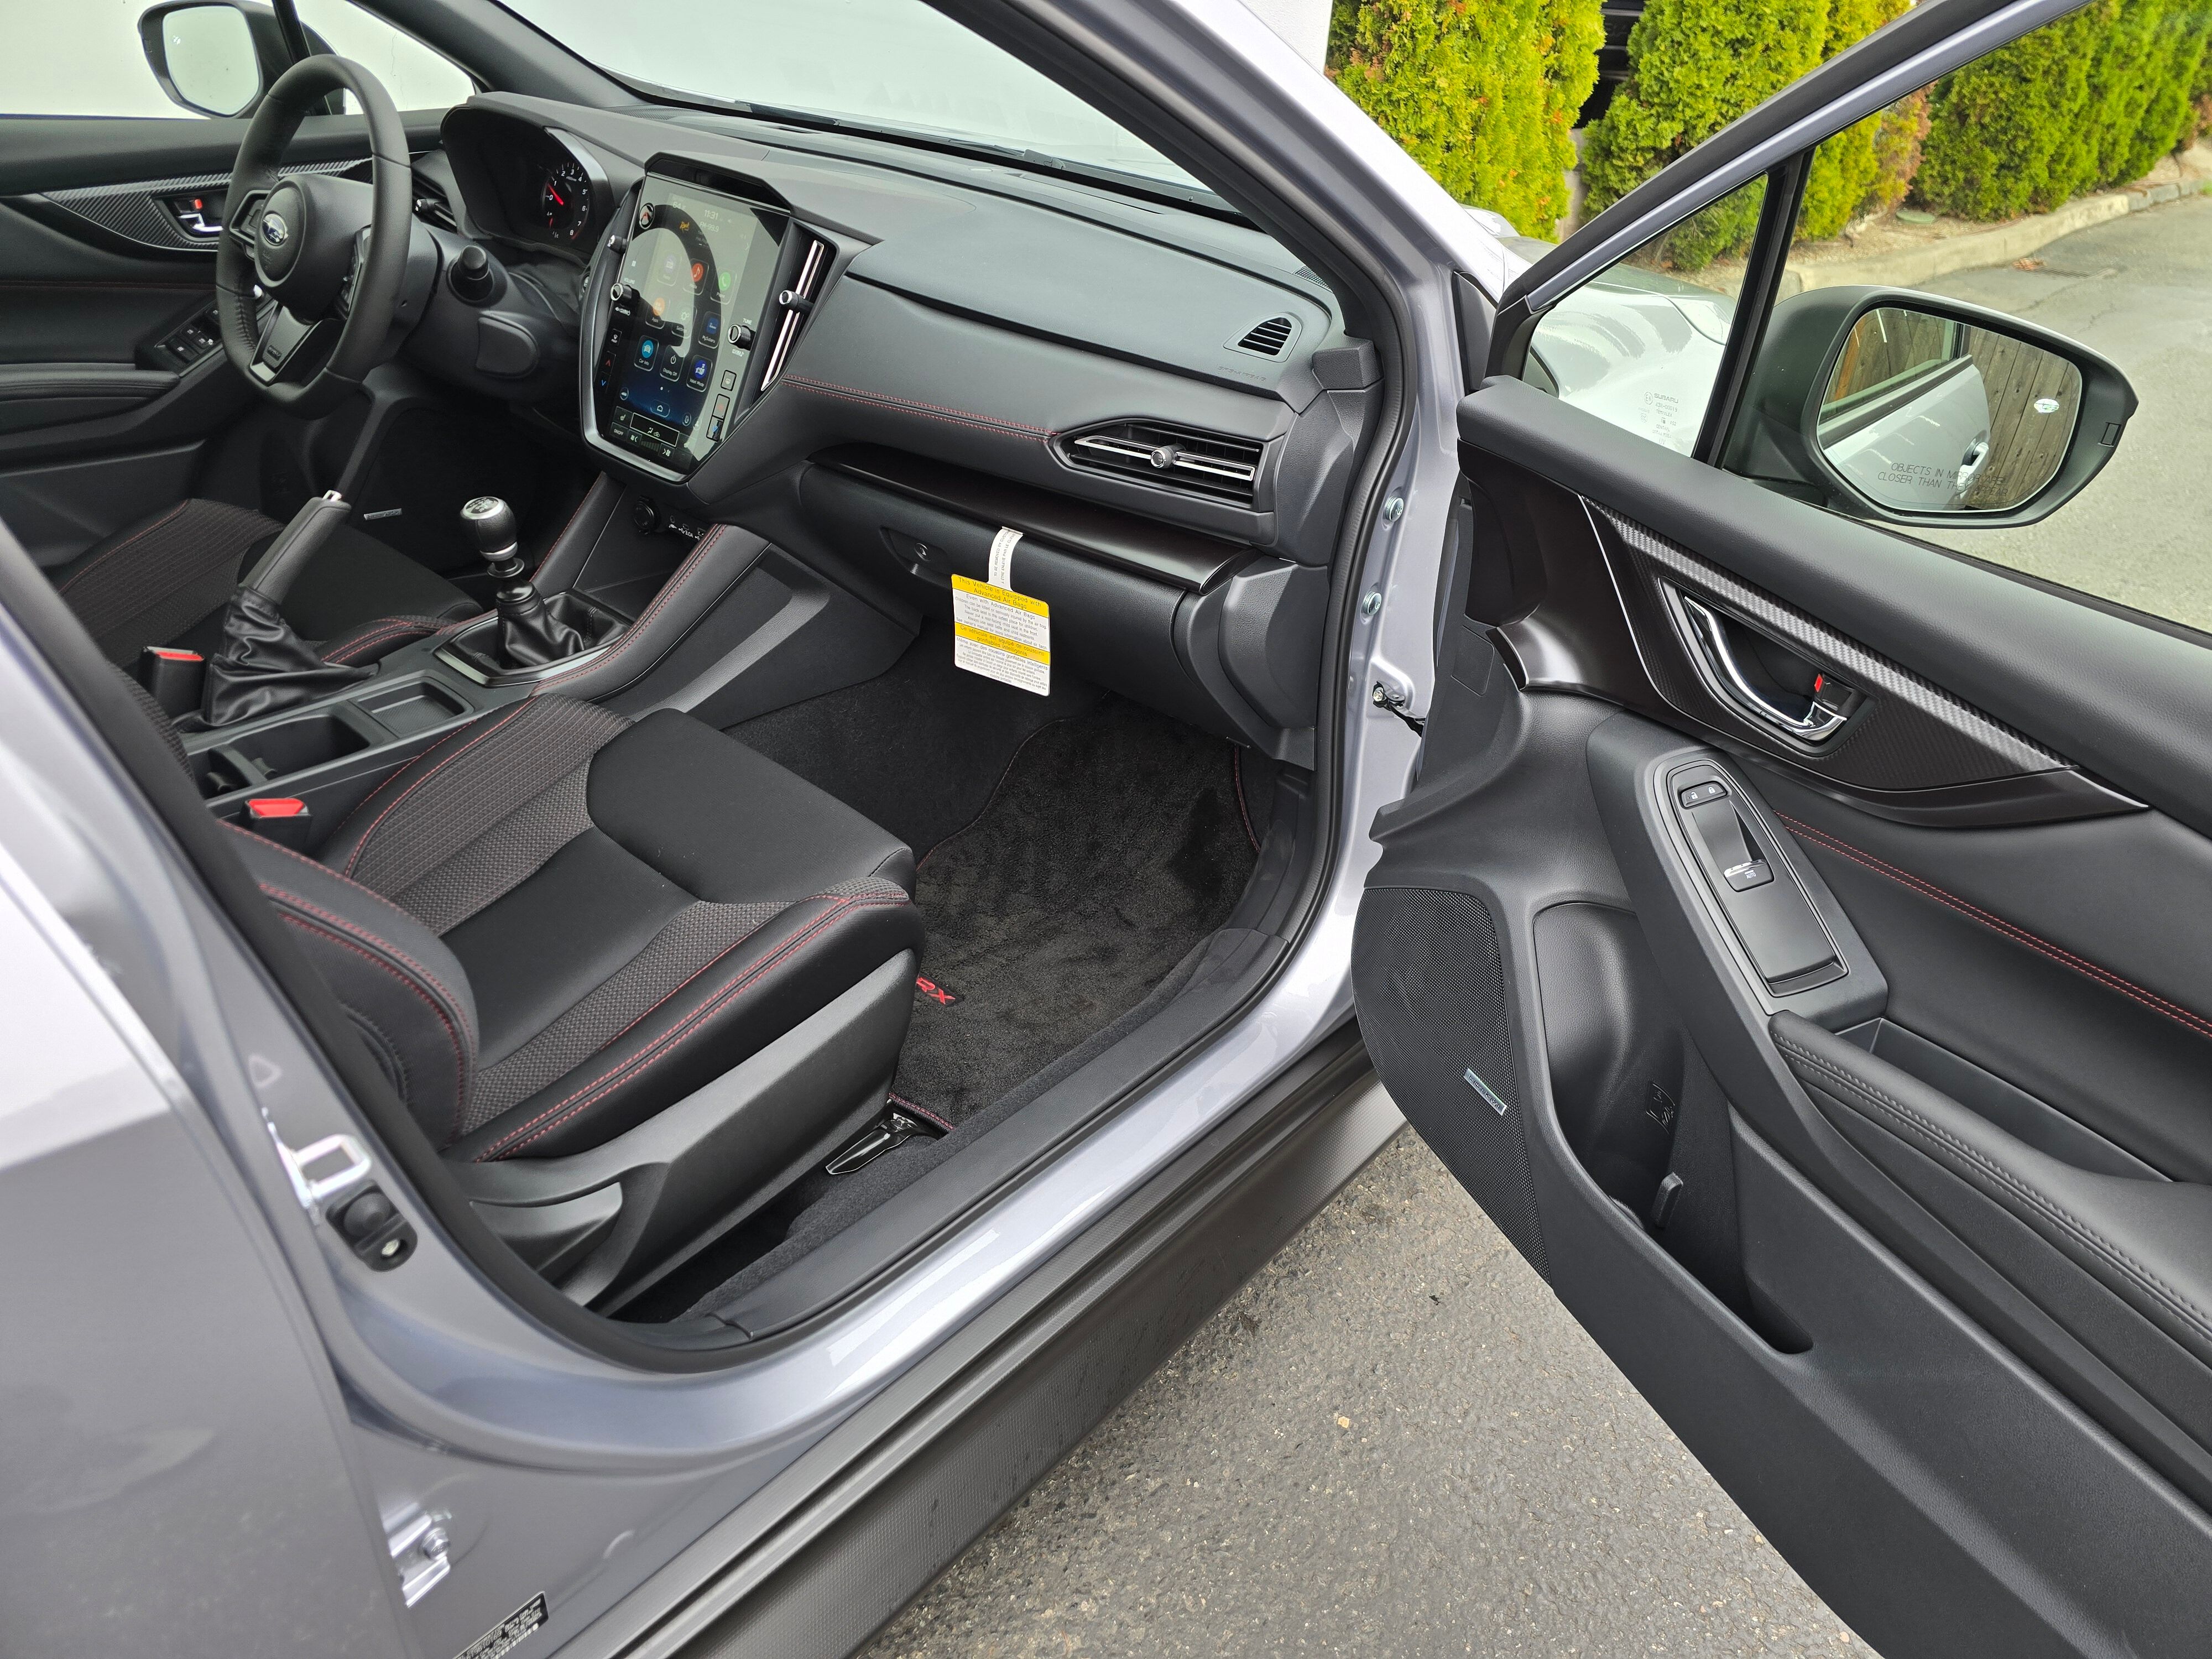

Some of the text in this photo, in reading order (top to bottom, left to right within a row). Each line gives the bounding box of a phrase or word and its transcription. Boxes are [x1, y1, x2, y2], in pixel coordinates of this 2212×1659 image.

[703, 209, 719, 220] 11:31
[1654, 393, 1678, 403] SUBARU
[1891, 462, 1932, 476] OBJECTS
[1935, 468, 1944, 477] IN
[1947, 471, 1980, 481] MIRROR
[1877, 471, 2008, 497] CLOSER THAN THEY APPEAR
[959, 577, 970, 585] This
[973, 581, 993, 592] Vehicle
[1002, 590, 1027, 603] Equipped
[974, 587, 1000, 601] Advanced
[1013, 599, 1026, 610] Bags
[990, 601, 1013, 613] Advanced
[1023, 612, 1035, 620] Bags
[968, 627, 987, 638] véhicule
[1024, 646, 1044, 656] coussins
[977, 636, 1027, 657] gonflables intelligents
[988, 648, 1005, 656] coussins
[1006, 653, 1025, 664] gonflables
[1027, 659, 1047, 671] intelligents
[916, 975, 956, 1005] RX
